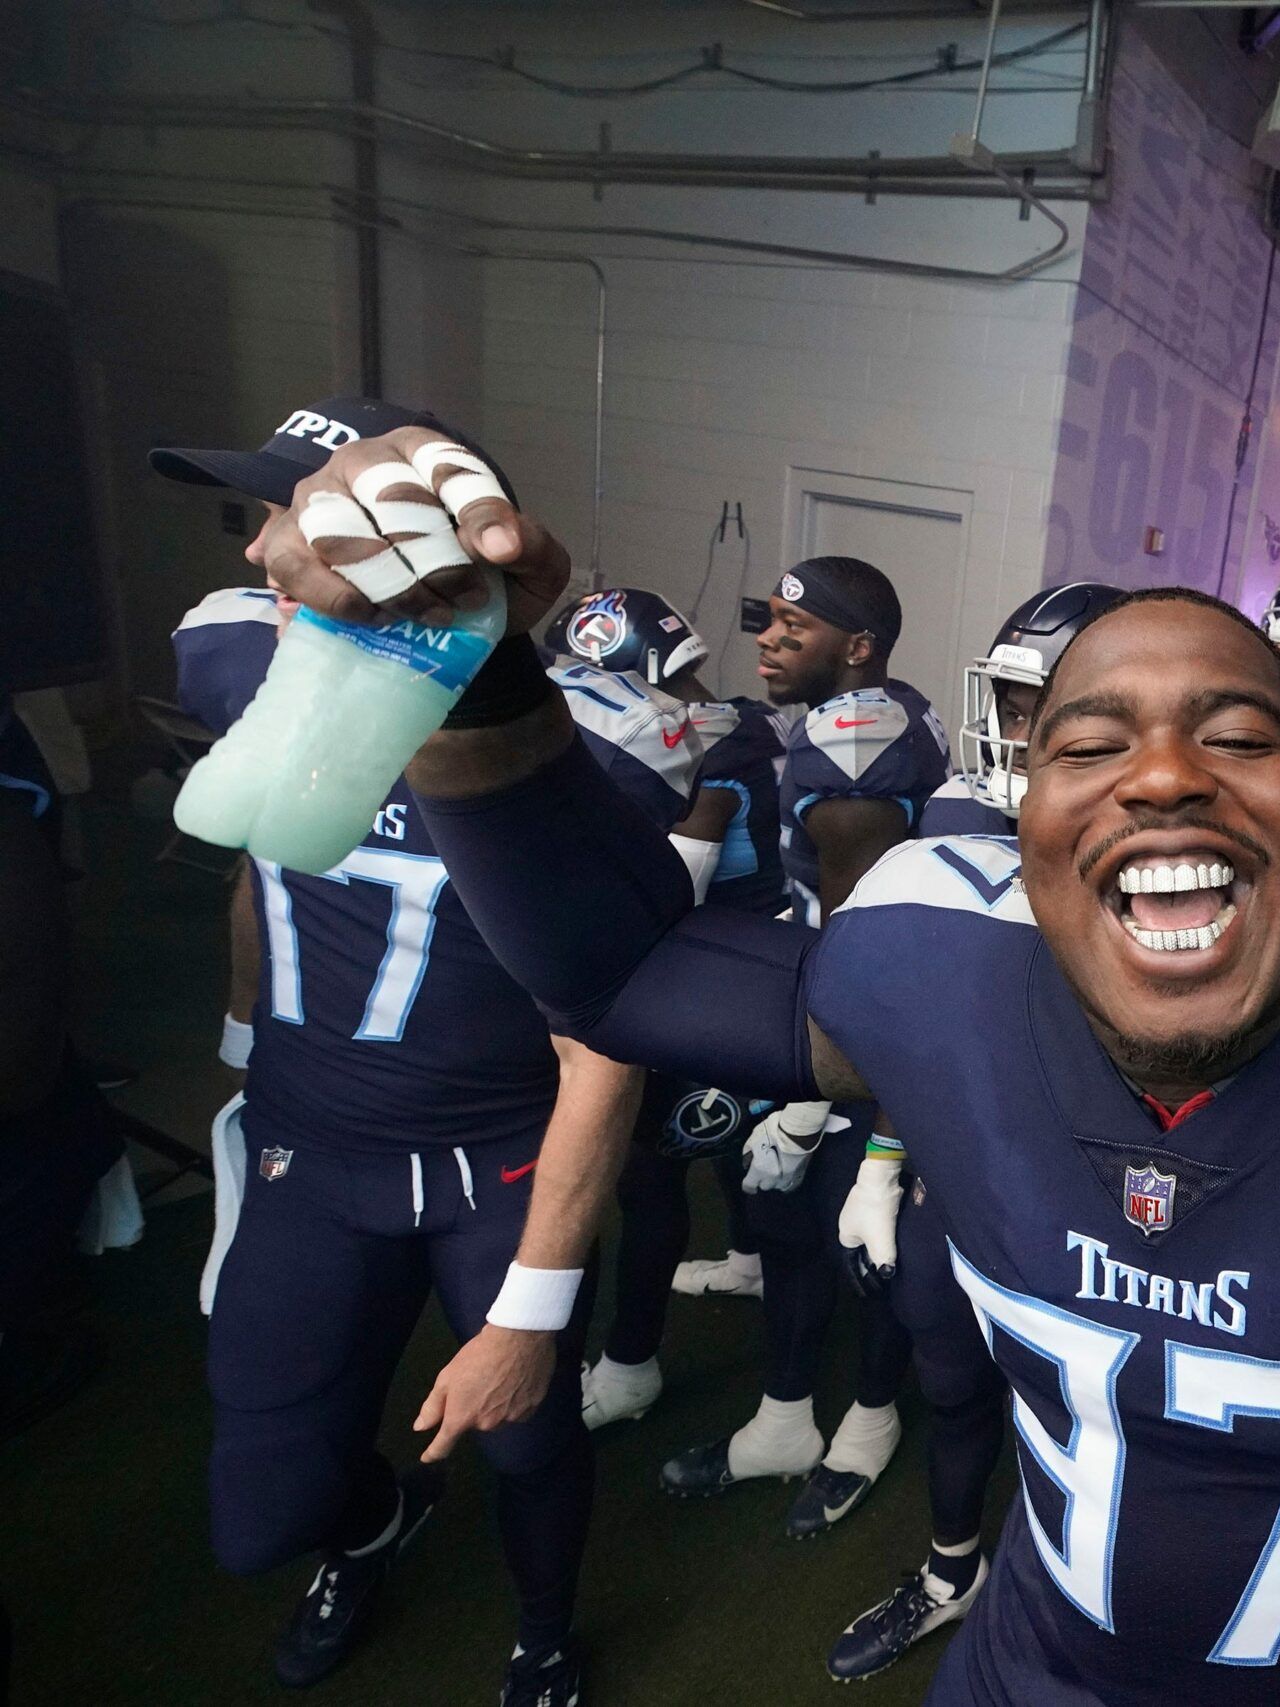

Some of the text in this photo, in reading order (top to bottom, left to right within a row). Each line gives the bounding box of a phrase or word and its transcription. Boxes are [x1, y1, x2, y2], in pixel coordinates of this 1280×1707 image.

[1087, 350, 1236, 587] 615
[251, 846, 450, 1042] 17
[1066, 1229, 1250, 1337] TITANS
[1129, 1193, 1165, 1224] NFL
